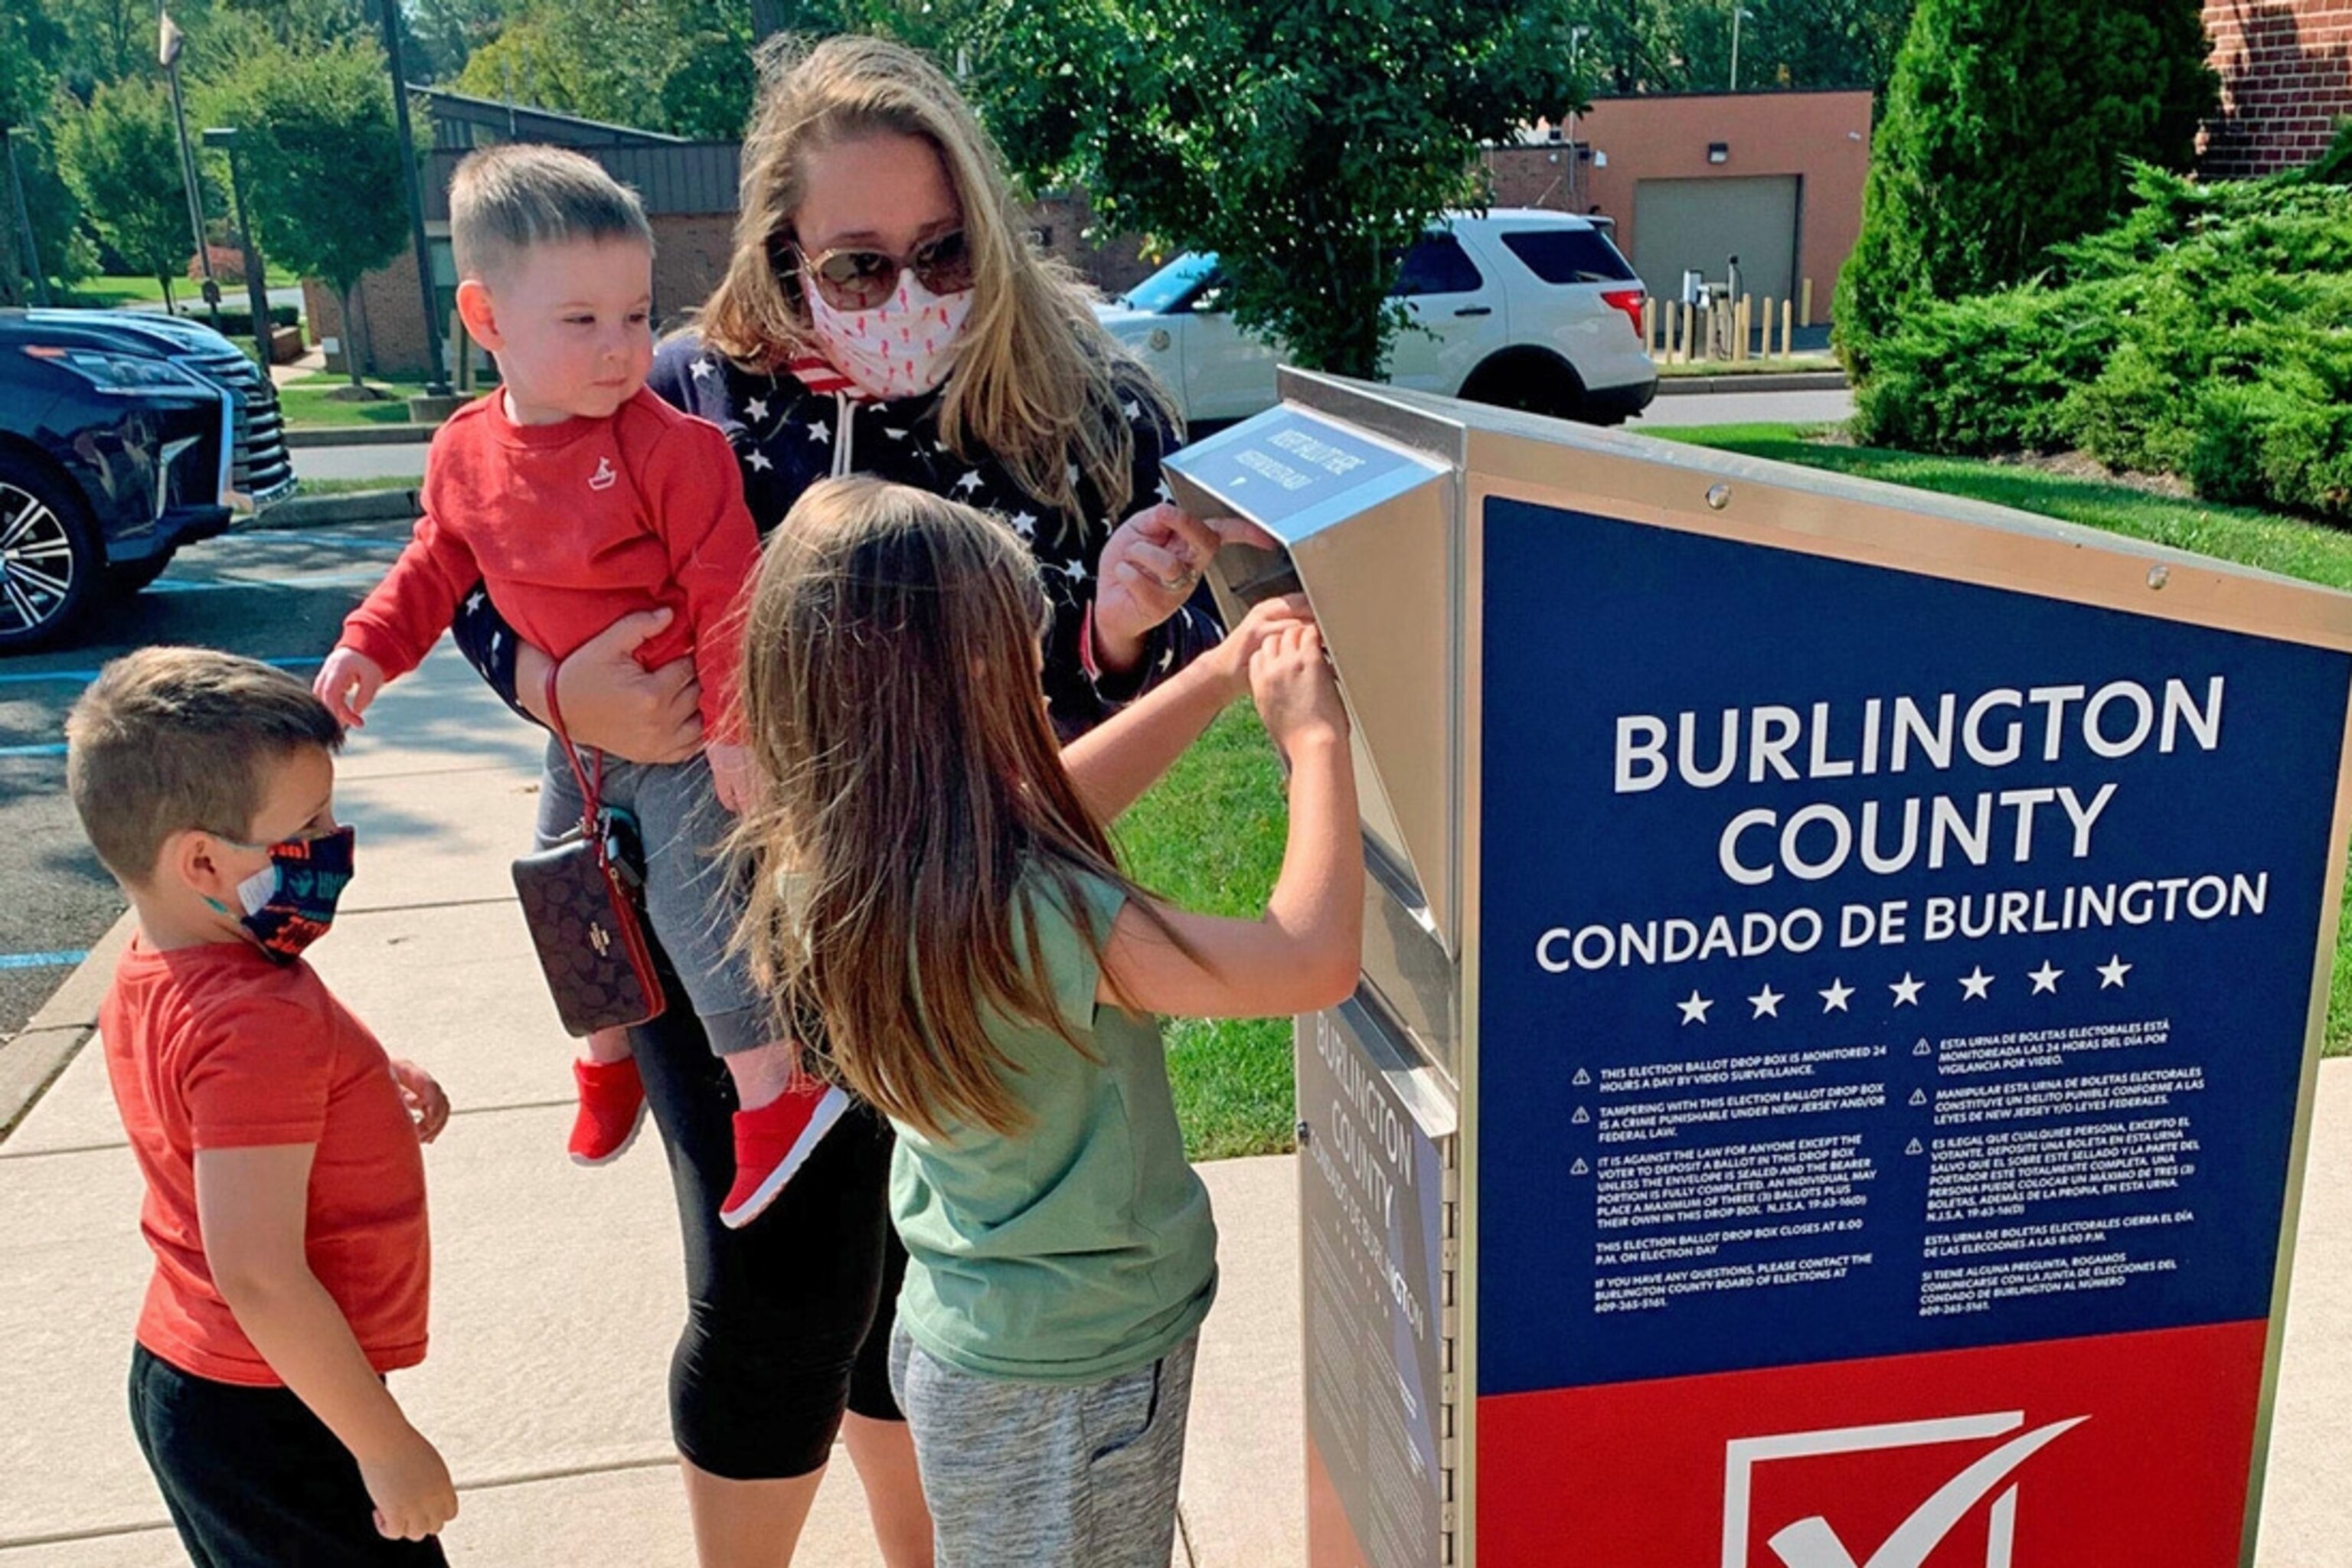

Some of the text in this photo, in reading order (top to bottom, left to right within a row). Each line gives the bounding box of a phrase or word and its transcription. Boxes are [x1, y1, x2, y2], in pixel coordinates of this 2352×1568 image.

[1614, 676, 2225, 793] BURLINGTON
[1719, 783, 2118, 885] COUNTY
[1535, 871, 2268, 972] CONDADO DE BURLINGTON
[1939, 1037, 1967, 1049] ESTA
[1968, 1035, 2000, 1047] URNA
[2001, 1034, 2017, 1044] DE
[2018, 1029, 2066, 1042] BOLETAS
[2068, 1022, 2141, 1037] ELECTORALES
[1939, 1046, 2022, 1062] MONITOREADA
[2023, 1044, 2044, 1054] LAS
[2046, 1042, 2060, 1052] 24
[2061, 1039, 2100, 1051] HORAS
[2100, 1037, 2122, 1047] DEL
[2144, 1033, 2167, 1044] POR
[1601, 1046, 1886, 1080] THIS ELECTION BALLOT DROP BOX IS MONITORED 24
[1937, 1060, 2001, 1074] VIGILANCIA
[2002, 1058, 2025, 1069] POR
[1315, 1009, 1413, 1186] BURLINGTON
[1599, 1080, 1640, 1092] HOURS
[1652, 1076, 1676, 1087] DAY
[1677, 1075, 1692, 1085] BY
[1694, 1072, 1729, 1083] VIDEO
[1935, 1096, 2003, 1111] CONSTITUYE
[2004, 1095, 2022, 1106] UN
[2024, 1091, 2063, 1103] DELITO
[2064, 1087, 2109, 1100] PUNIBLE
[2111, 1082, 2173, 1096] CONFORME
[2184, 1079, 2204, 1089] LAS
[1936, 1067, 2202, 1099] MANIPULAR ESTA URNA DE BOLETAS ELECTORALES
[1599, 1120, 1609, 1129] IS
[1621, 1116, 1657, 1128] CRIME
[1658, 1109, 1728, 1124] PUNISHABLE
[1730, 1106, 1769, 1118] UNDER
[1771, 1103, 1798, 1114] NEW
[1799, 1099, 1838, 1112] JERSEY
[1600, 1083, 1883, 1116] TAMPERING WITH THIS ELECTION BALLOT DROP BOX
[1933, 1112, 1967, 1124] LEYES
[1968, 1111, 1984, 1121] DE
[1984, 1109, 2011, 1119] NEW
[2014, 1105, 2050, 1117] JERSEY
[2074, 1100, 2106, 1112] LEYES
[1599, 1129, 1646, 1142] FEDERAL
[1599, 1134, 1861, 1166] IT IS AGAINST THE LAW FOR ANYONE EXCEPT THE
[1331, 1099, 1393, 1229] COUNTY
[1597, 1158, 1870, 1191] UNLESS THE ENVELOPE IS SEALED AND THE BEARER
[1598, 1167, 1635, 1178] VOTER
[1636, 1165, 1652, 1175] TO
[1654, 1161, 1700, 1174] DEPOSIT
[1713, 1156, 1755, 1168] BALLOT
[1757, 1155, 1769, 1165] IN
[1772, 1152, 1797, 1163] THIS
[1798, 1149, 1830, 1161] DROP
[1831, 1147, 1854, 1158] BOX
[1597, 1191, 1648, 1204] PORTION
[1649, 1189, 1660, 1199] IS
[1661, 1186, 1695, 1197] FULLY
[1766, 1178, 1784, 1188] AN
[1850, 1170, 1876, 1181] MAY
[1596, 1241, 1621, 1252] THIS
[1623, 1236, 1676, 1250] ELECTION
[1678, 1232, 1720, 1244] BALLOT
[1721, 1229, 1753, 1240] DROP
[1753, 1227, 1777, 1237] BOX
[1779, 1223, 1820, 1235] CLOSES
[1821, 1222, 1836, 1231] AT
[1924, 1233, 1951, 1243] ESTA
[1952, 1230, 1983, 1241] URNA
[1984, 1229, 1999, 1238] DE
[2001, 1224, 2047, 1237] BOLETAS
[2049, 1218, 2121, 1233] ELECTORALES
[2160, 1214, 2173, 1223] EL
[1620, 1252, 1638, 1262] ON
[1640, 1246, 1693, 1260] ELECTION
[1694, 1245, 1717, 1255] DAY
[1923, 1246, 1938, 1256] DE
[1940, 1244, 1960, 1254] LAS
[1962, 1239, 2026, 1253] ELECCIONES
[2037, 1236, 2057, 1246] LAS
[1595, 1279, 1605, 1288] IF
[1606, 1276, 1631, 1287] YOU
[1632, 1273, 1662, 1284] HAVE
[1664, 1271, 1688, 1282] ANY
[1756, 1261, 1795, 1272] PLEASE
[1797, 1256, 1849, 1269] CONTACT
[1850, 1254, 1871, 1264] THE
[1595, 1268, 1847, 1299] BURLINGTON COUNTY BOARD OF ELECTIONS AT
